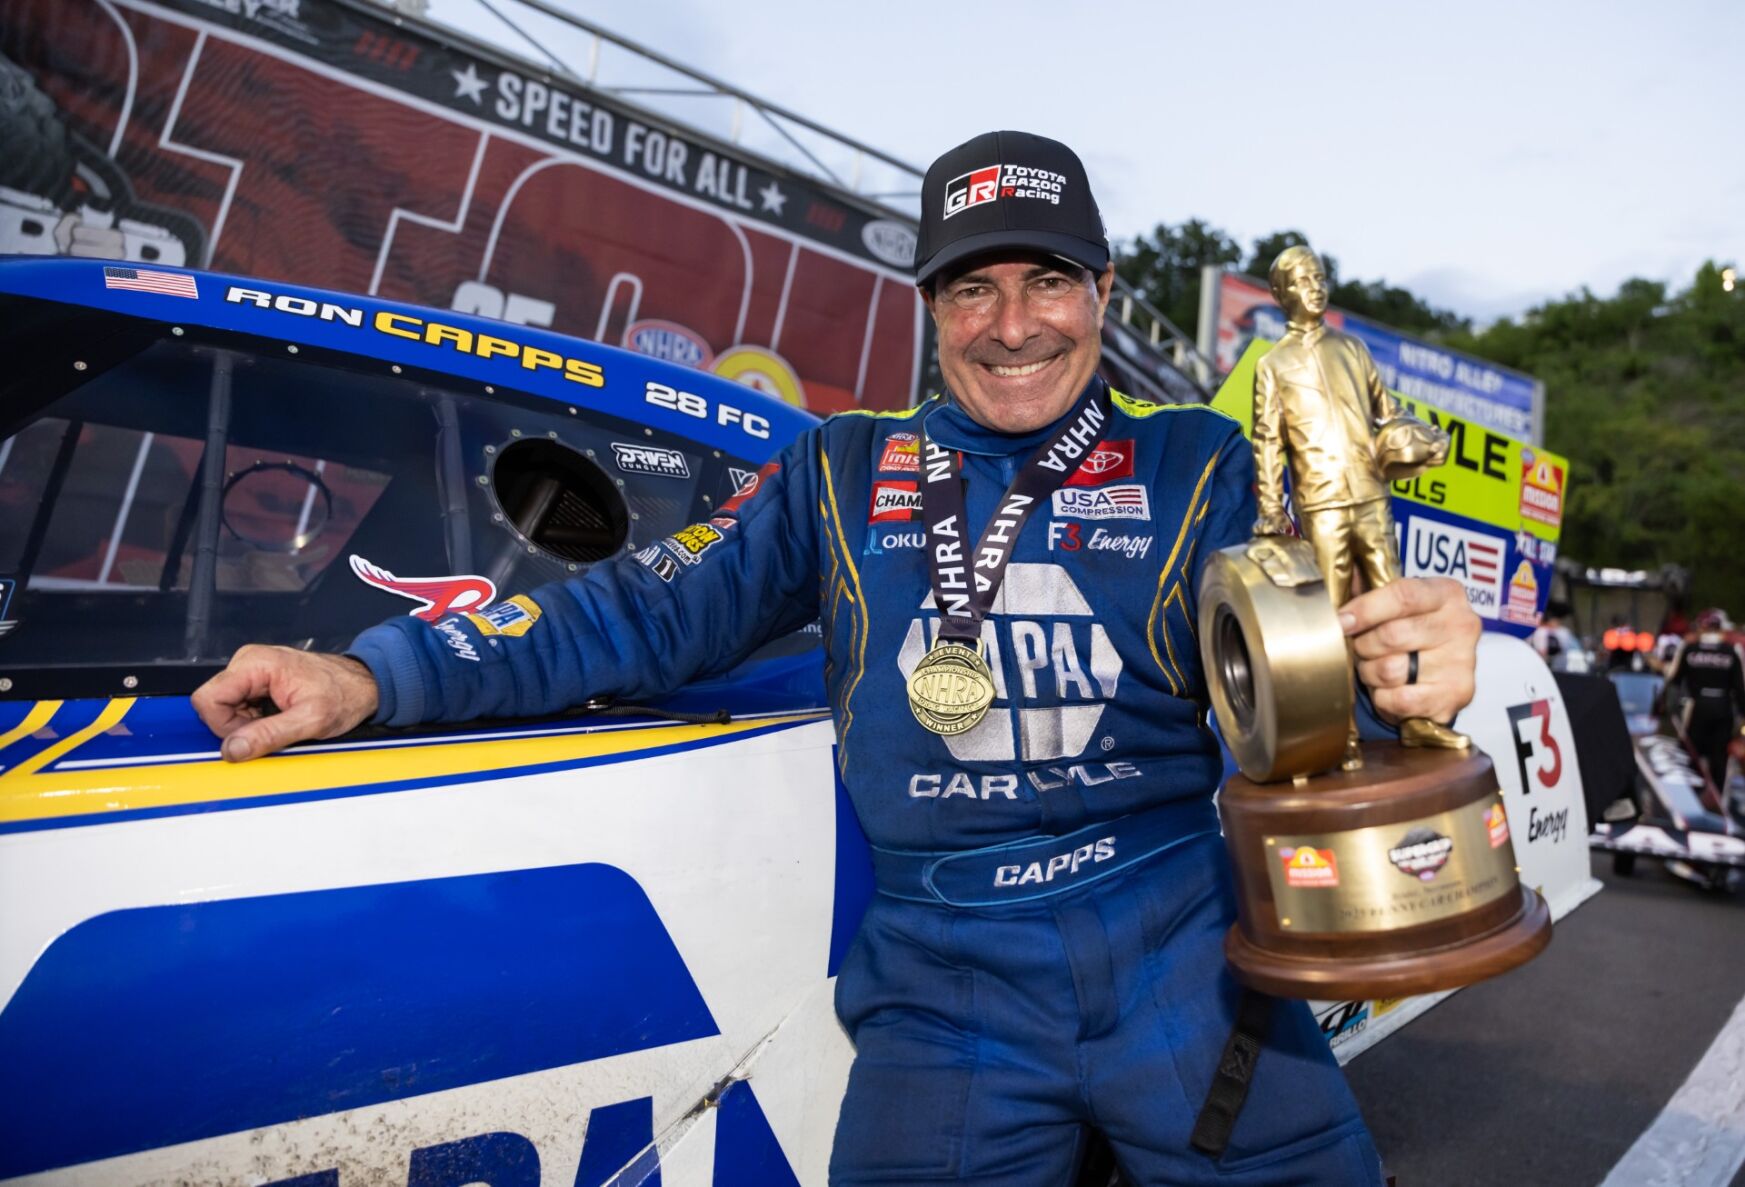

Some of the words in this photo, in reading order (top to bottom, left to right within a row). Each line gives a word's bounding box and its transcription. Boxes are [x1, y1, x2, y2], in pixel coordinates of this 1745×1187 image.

[496, 71, 613, 155] SPEED
[624, 122, 688, 186] FOR
[695, 152, 753, 209] ALL
[1001, 175, 1062, 193] GAZOO
[1004, 164, 1067, 185] TOYOTA
[946, 181, 996, 214] GR
[1001, 187, 1060, 205] Racing
[226, 286, 363, 328] RON
[373, 310, 605, 388] CAPPS
[645, 381, 708, 419] 28
[717, 403, 770, 440] FC
[1038, 400, 1107, 473] NHRA
[616, 447, 684, 468] DRIVEN
[622, 462, 686, 475] SUNGLASSES
[925, 434, 951, 484] NH
[876, 494, 923, 508] CHAM
[1060, 491, 1112, 507] USA
[1061, 505, 1144, 516] COMPRESSION
[882, 533, 927, 549] OKU
[974, 494, 1034, 592] NHRA
[1048, 521, 1082, 552] F3
[1088, 527, 1153, 559] Energy
[1415, 528, 1468, 579] USA
[932, 515, 972, 618] NHRA
[939, 647, 972, 657] EVENT
[920, 674, 979, 704] NHRA
[926, 718, 964, 732] WINNER
[1506, 698, 1562, 795] F3
[908, 762, 1143, 800] CARLYLE
[1528, 806, 1568, 845] Energy
[994, 836, 1116, 888] CAPPS
